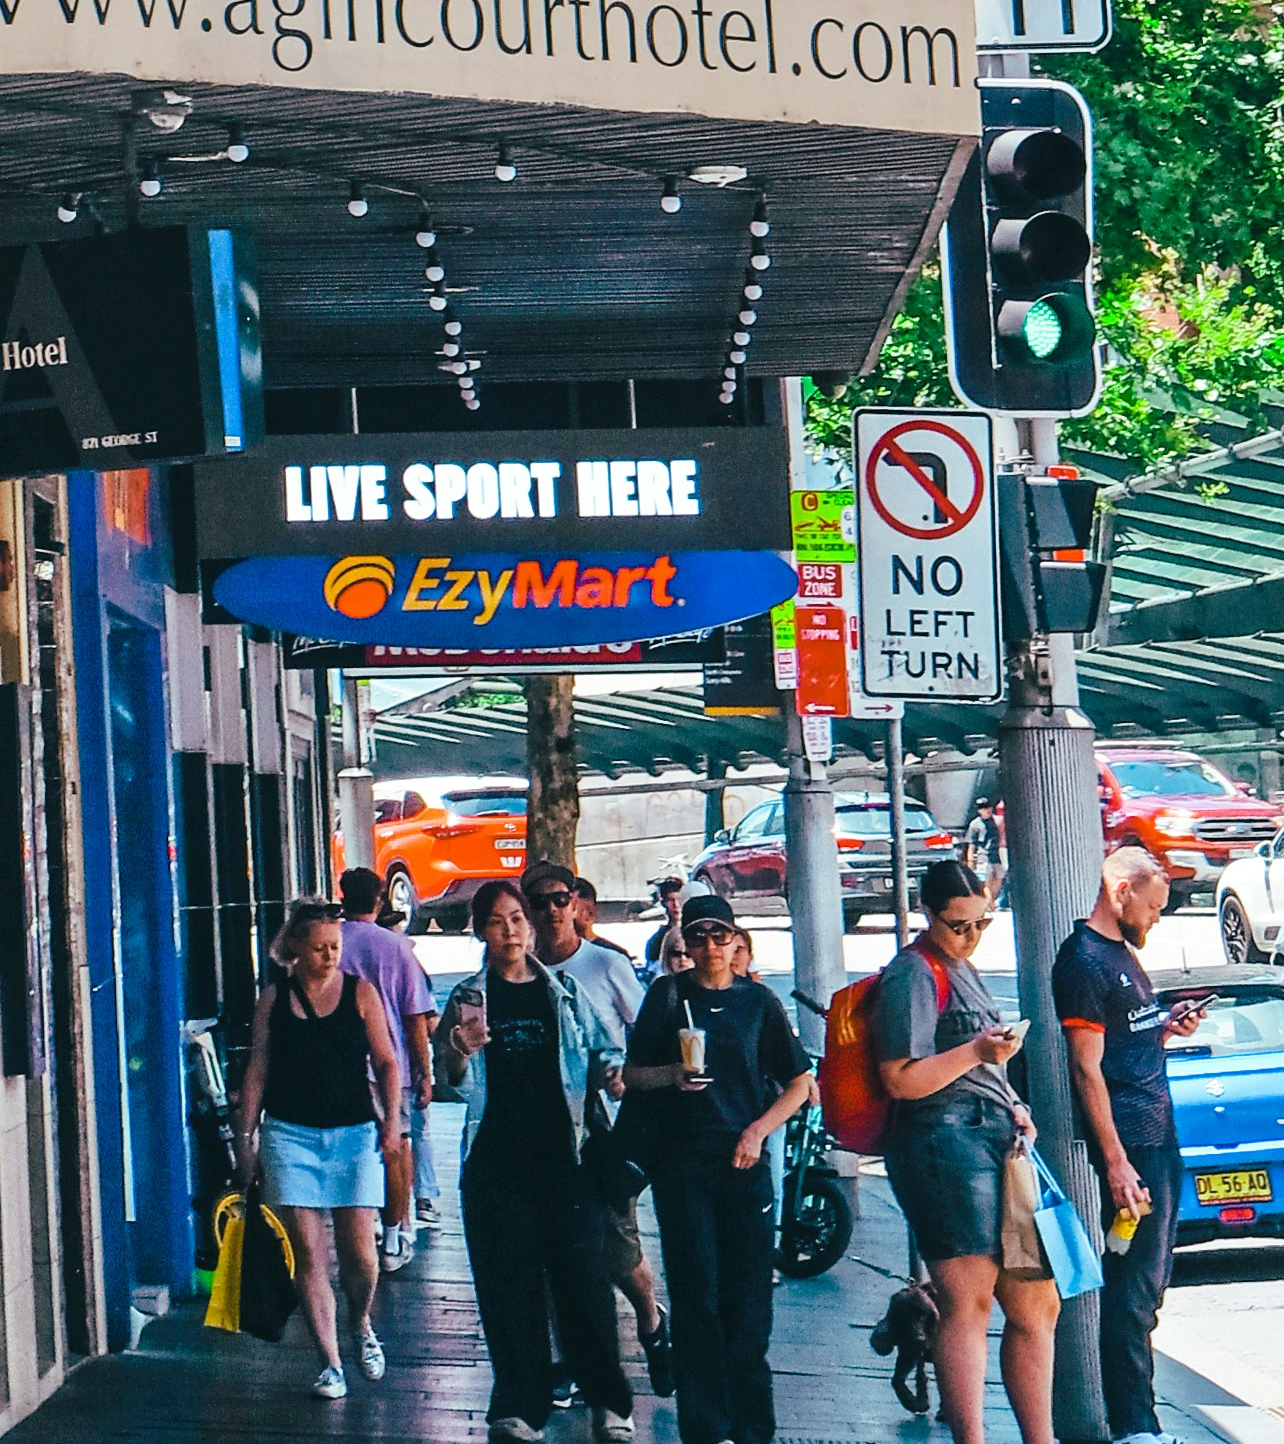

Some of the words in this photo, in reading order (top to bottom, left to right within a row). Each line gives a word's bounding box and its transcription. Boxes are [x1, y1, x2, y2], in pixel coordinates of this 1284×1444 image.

[1, 336, 68, 371] Hotel
[101, 432, 141, 448] GEORGE
[145, 430, 159, 444] ST
[284, 464, 389, 523] LIVE
[403, 461, 562, 520] SPORT
[576, 459, 700, 517] HERE
[802, 566, 836, 580] BUS
[892, 555, 964, 597] NO
[401, 554, 676, 625] EzyMart
[805, 582, 837, 597] ZONE
[812, 615, 827, 625] NO
[886, 610, 974, 638] LEFT
[801, 629, 840, 641] STOPPING
[881, 652, 980, 681] TURN
